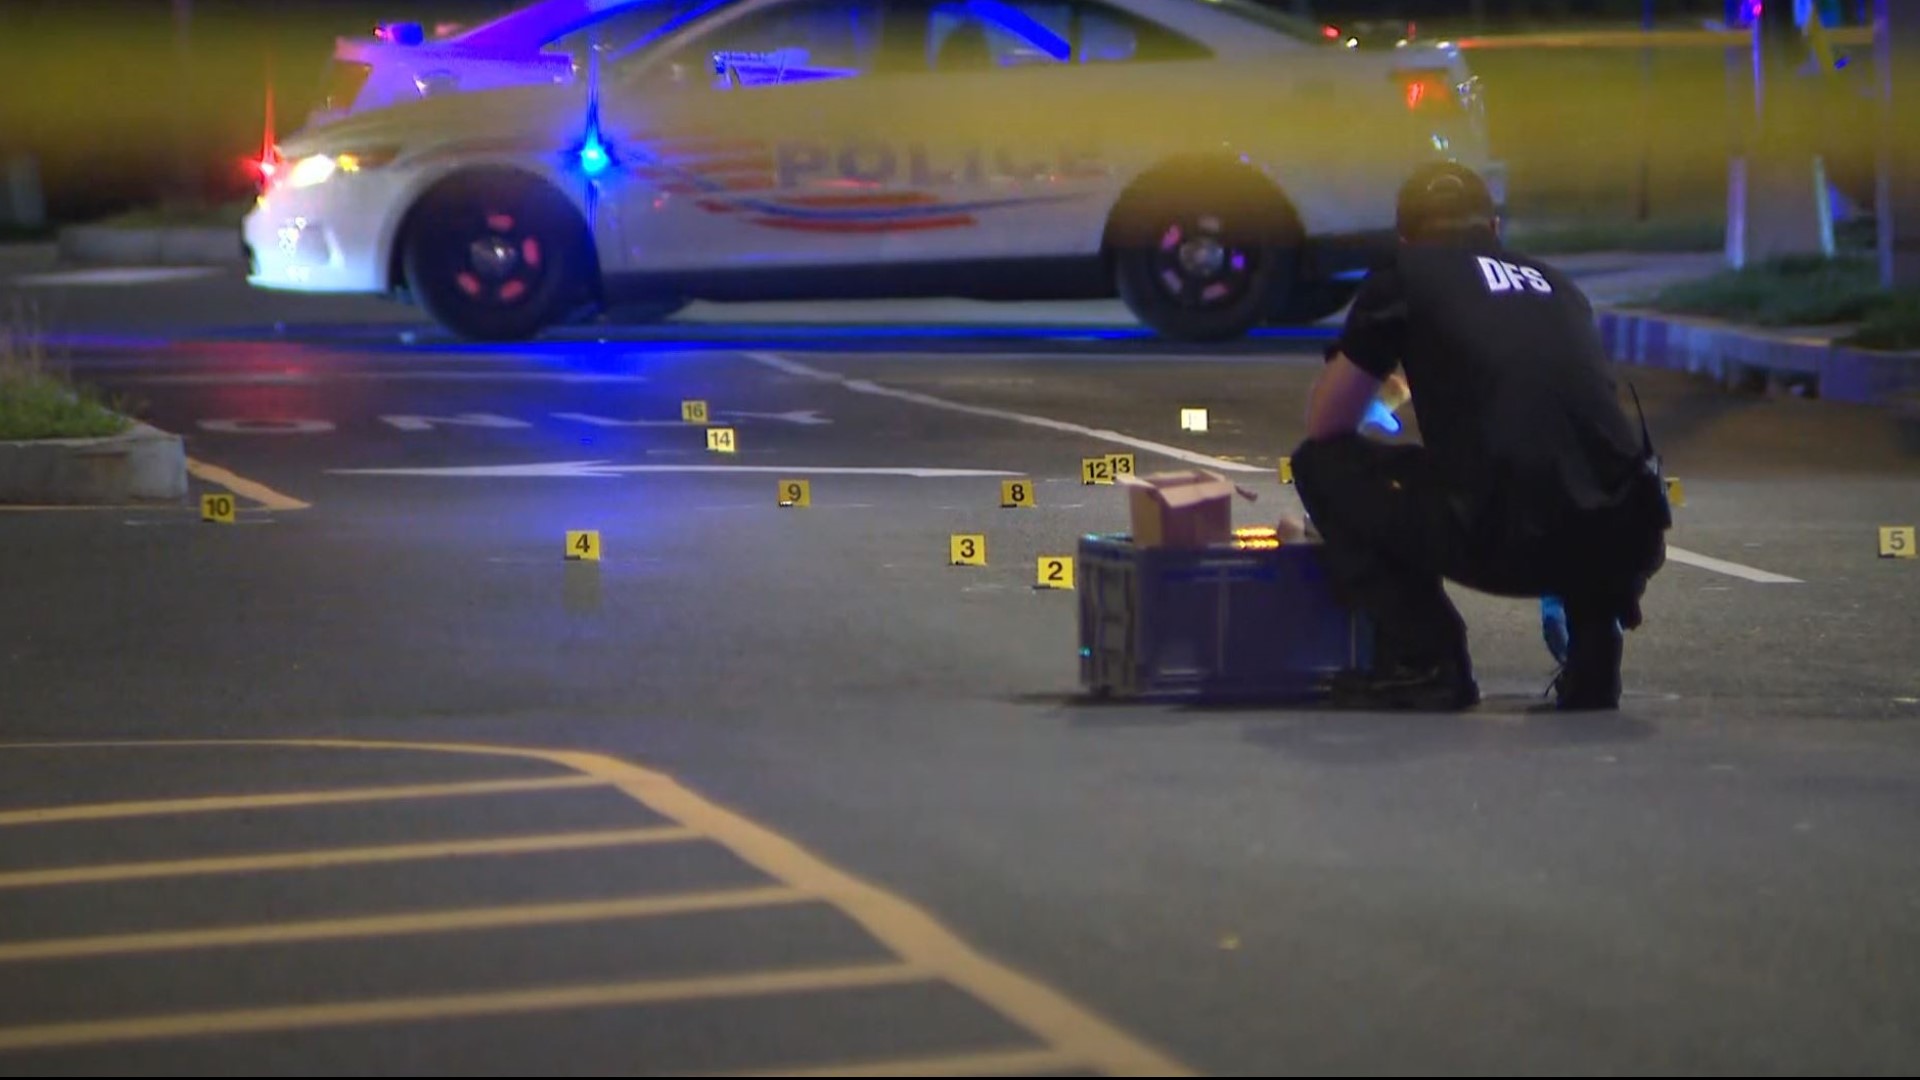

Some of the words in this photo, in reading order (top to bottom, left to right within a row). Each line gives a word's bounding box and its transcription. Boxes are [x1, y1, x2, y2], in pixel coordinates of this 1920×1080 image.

[776, 136, 1106, 187] POLICE
[1477, 256, 1552, 292] DFS
[684, 403, 704, 418] 16
[710, 431, 731, 447] 14
[1086, 461, 1108, 478] 12
[1110, 457, 1131, 474] 13
[788, 483, 802, 502] 9
[1011, 483, 1025, 502] 8
[206, 497, 230, 516] 10
[575, 533, 591, 553] 4
[960, 538, 975, 559] 3
[1890, 530, 1905, 551] 5
[1047, 560, 1064, 581] 2
